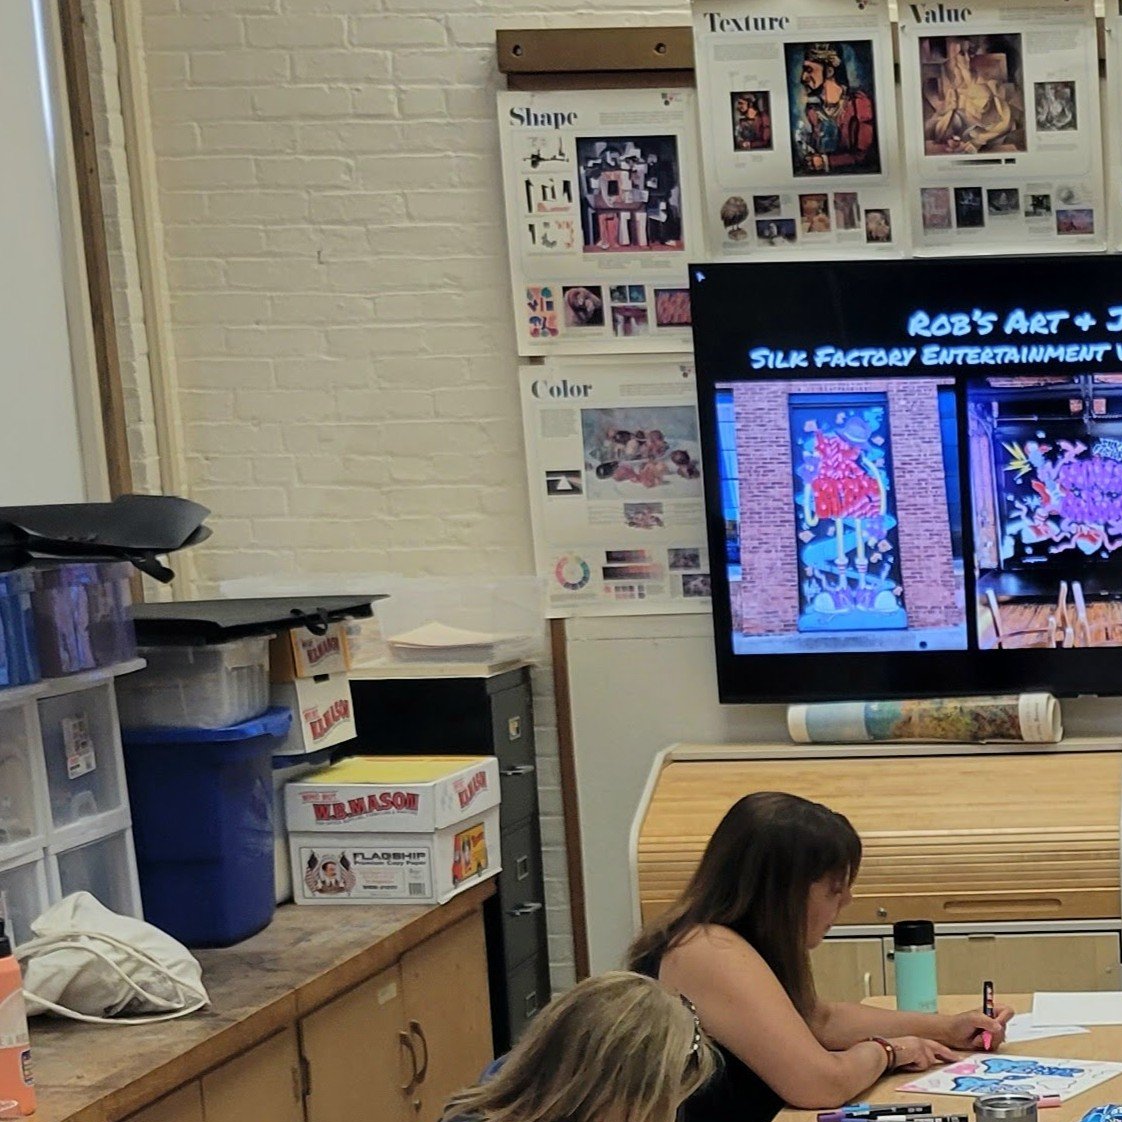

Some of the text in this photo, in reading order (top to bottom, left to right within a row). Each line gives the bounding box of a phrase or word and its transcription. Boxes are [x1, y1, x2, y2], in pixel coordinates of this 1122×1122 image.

[703, 12, 790, 33] Texture
[908, 3, 973, 24] Value
[509, 107, 578, 130] Shape
[1003, 309, 1070, 335] ART
[750, 347, 809, 369] SILK
[815, 346, 917, 368] FACTORY
[921, 341, 1111, 366] ENTERTAINMENT
[531, 379, 593, 399] Color
[353, 852, 427, 861] FLAGSHIP
